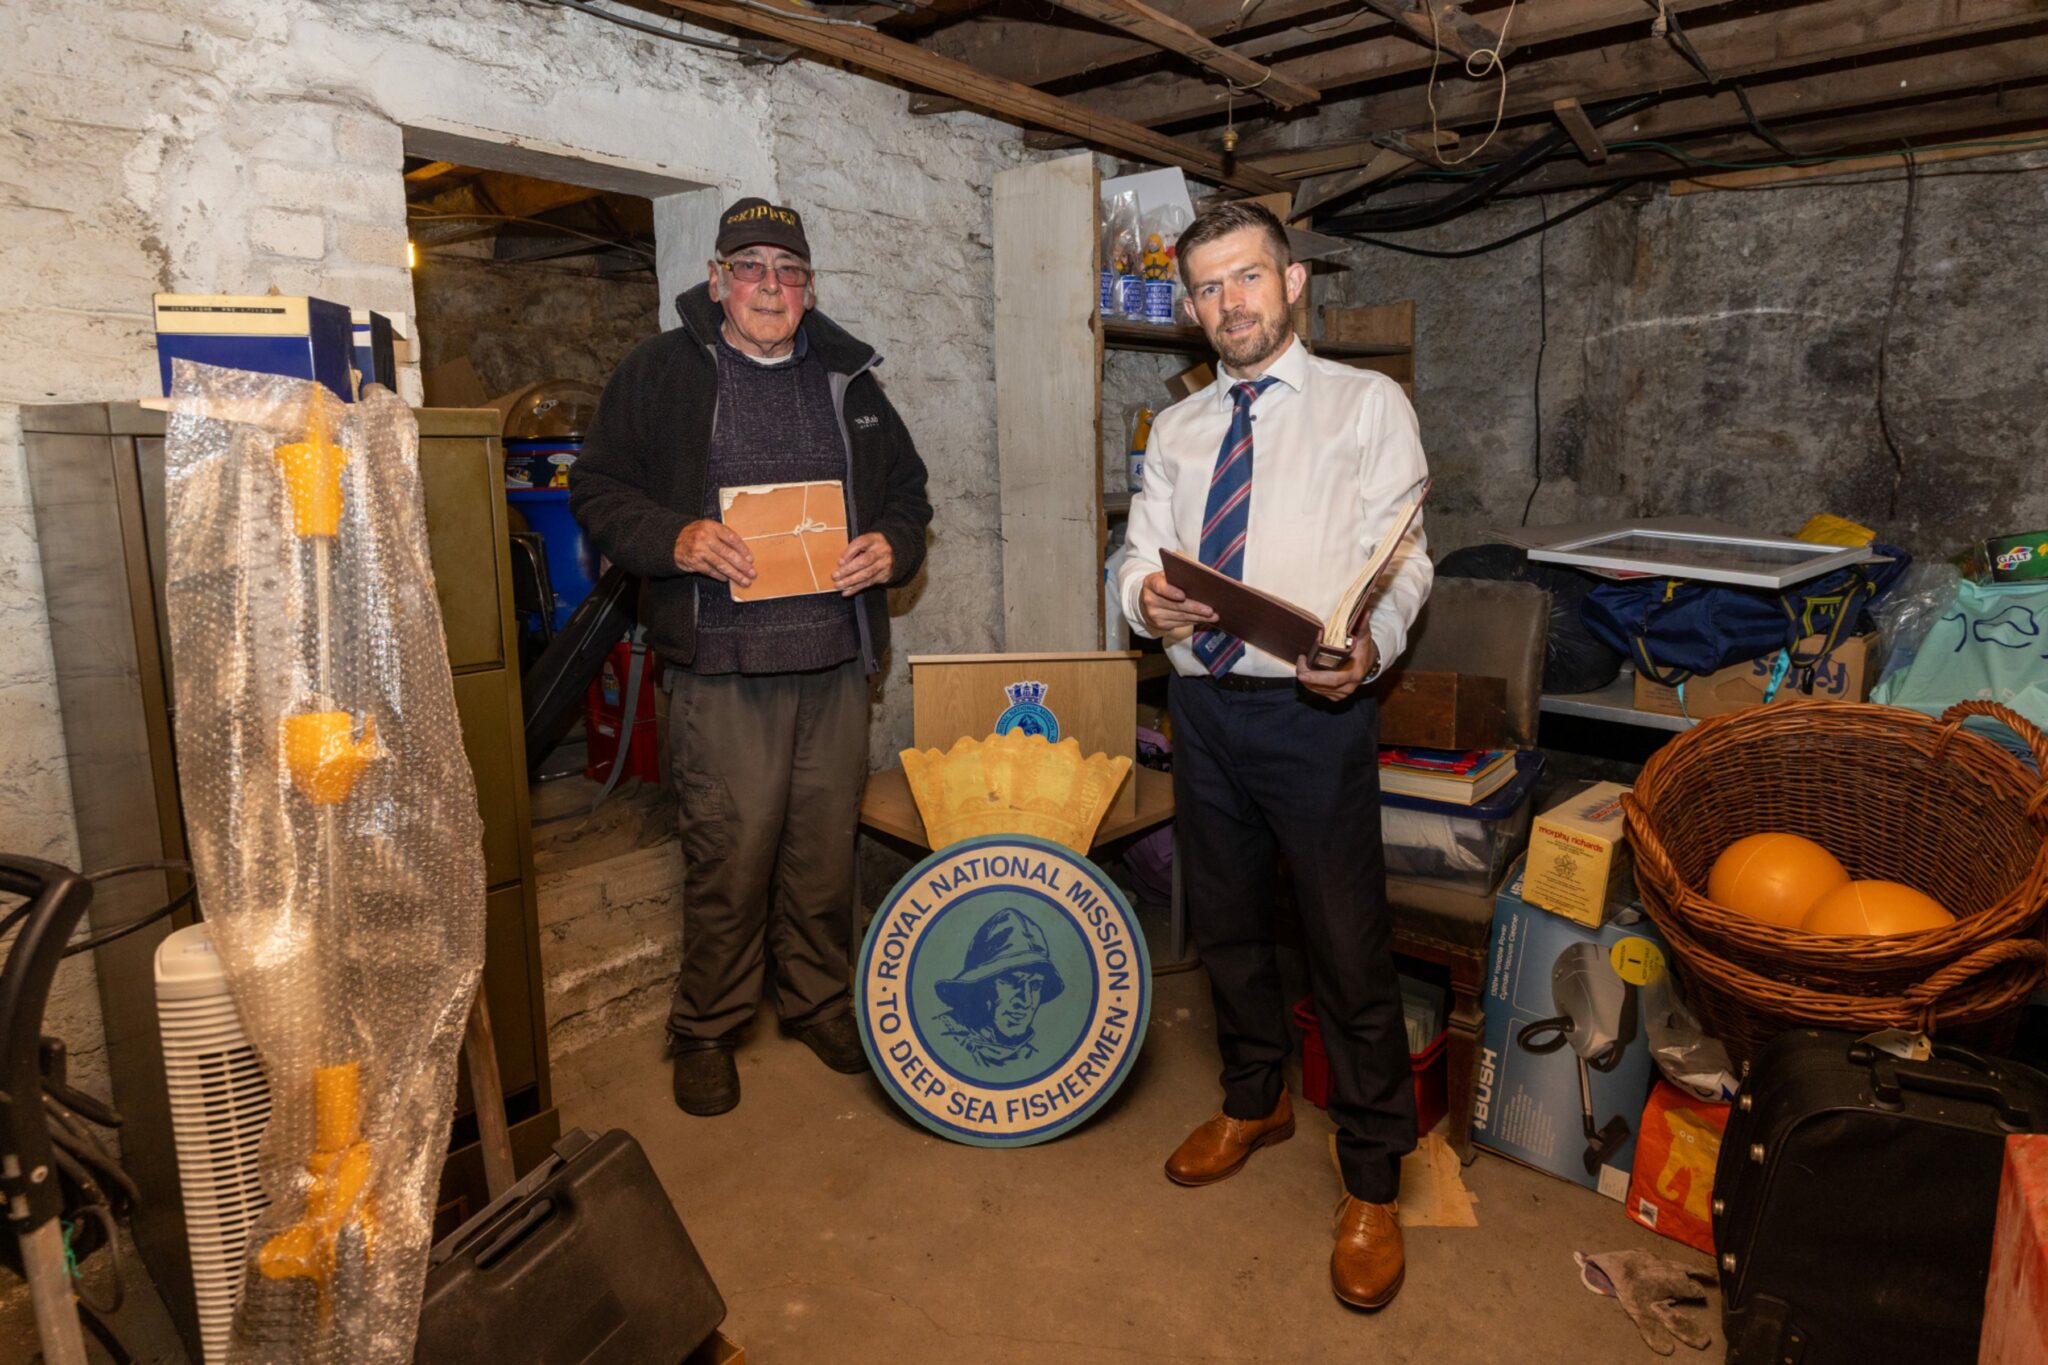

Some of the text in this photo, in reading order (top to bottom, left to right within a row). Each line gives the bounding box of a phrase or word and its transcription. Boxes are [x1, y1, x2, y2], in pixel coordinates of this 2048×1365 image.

[1999, 552, 2028, 563] GALT
[1538, 826, 1569, 842] morphy
[1571, 837, 1604, 853] richards
[878, 855, 1130, 991] ROYAL NATIONAL MISSION
[1498, 923, 1507, 945] Power
[1499, 912, 1519, 1000] Cylinder Vacuum Cleaner
[876, 997, 1129, 1124] TO DEEP SEA FISHERMEN
[1473, 1047, 1498, 1121] BUSH
